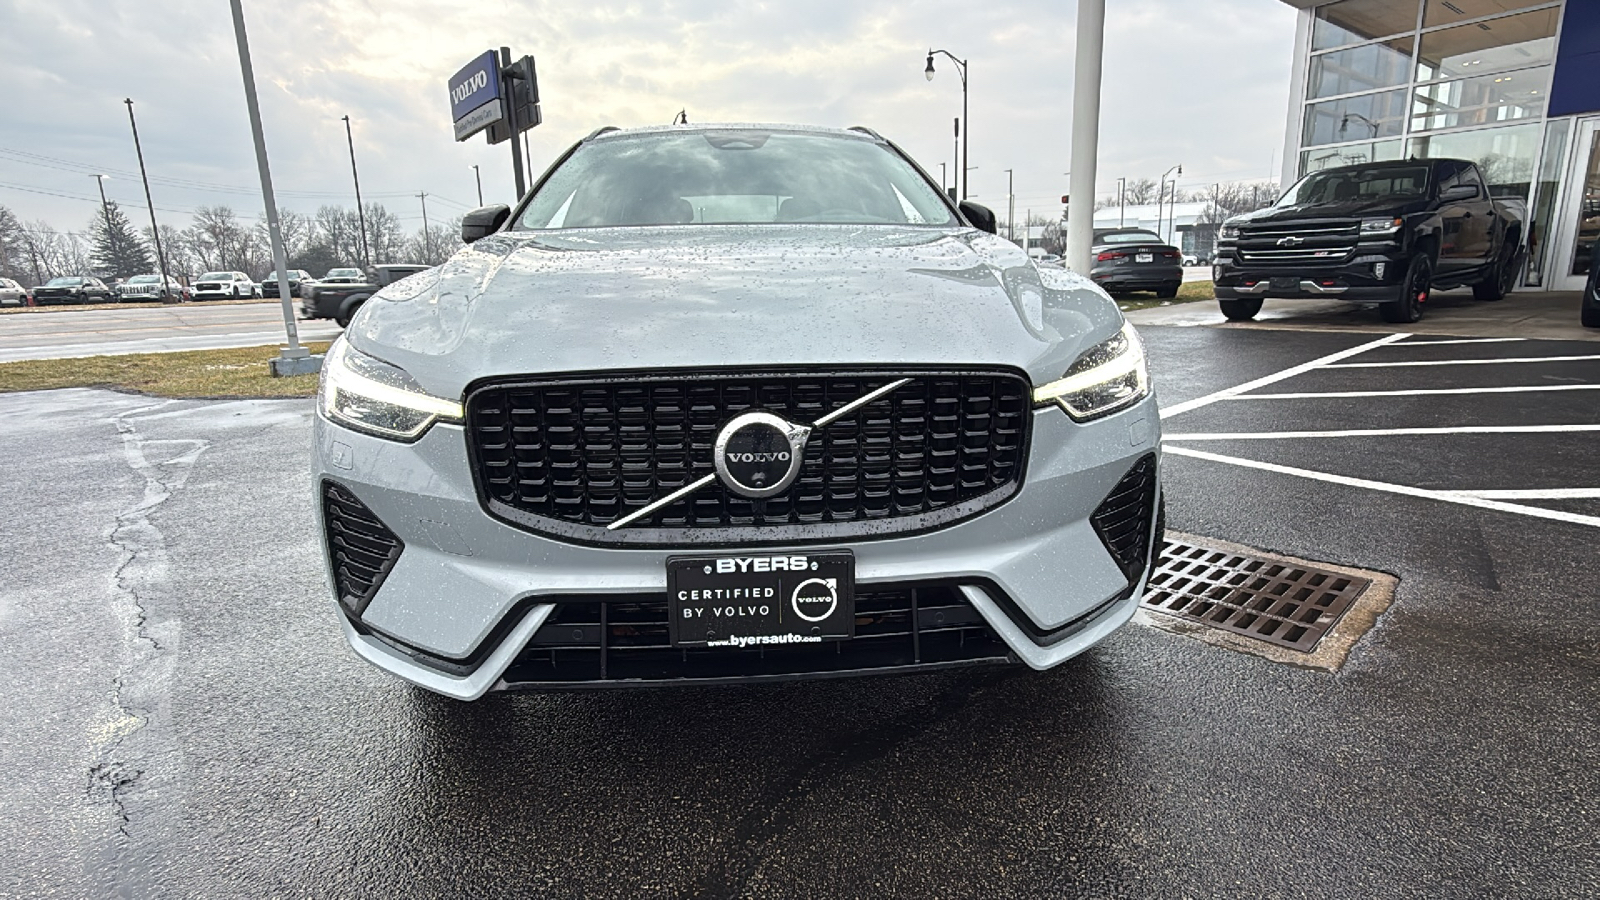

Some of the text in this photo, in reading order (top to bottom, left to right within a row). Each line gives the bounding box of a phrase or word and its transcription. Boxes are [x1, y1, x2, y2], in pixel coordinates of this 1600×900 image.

[452, 70, 487, 104] VOLVO
[727, 452, 790, 462] VOLVO
[716, 556, 808, 573] BYERS
[678, 587, 774, 601] CERTIFIED
[683, 605, 769, 619] BY VOLVO
[707, 633, 822, 648] www.byersauto.com
